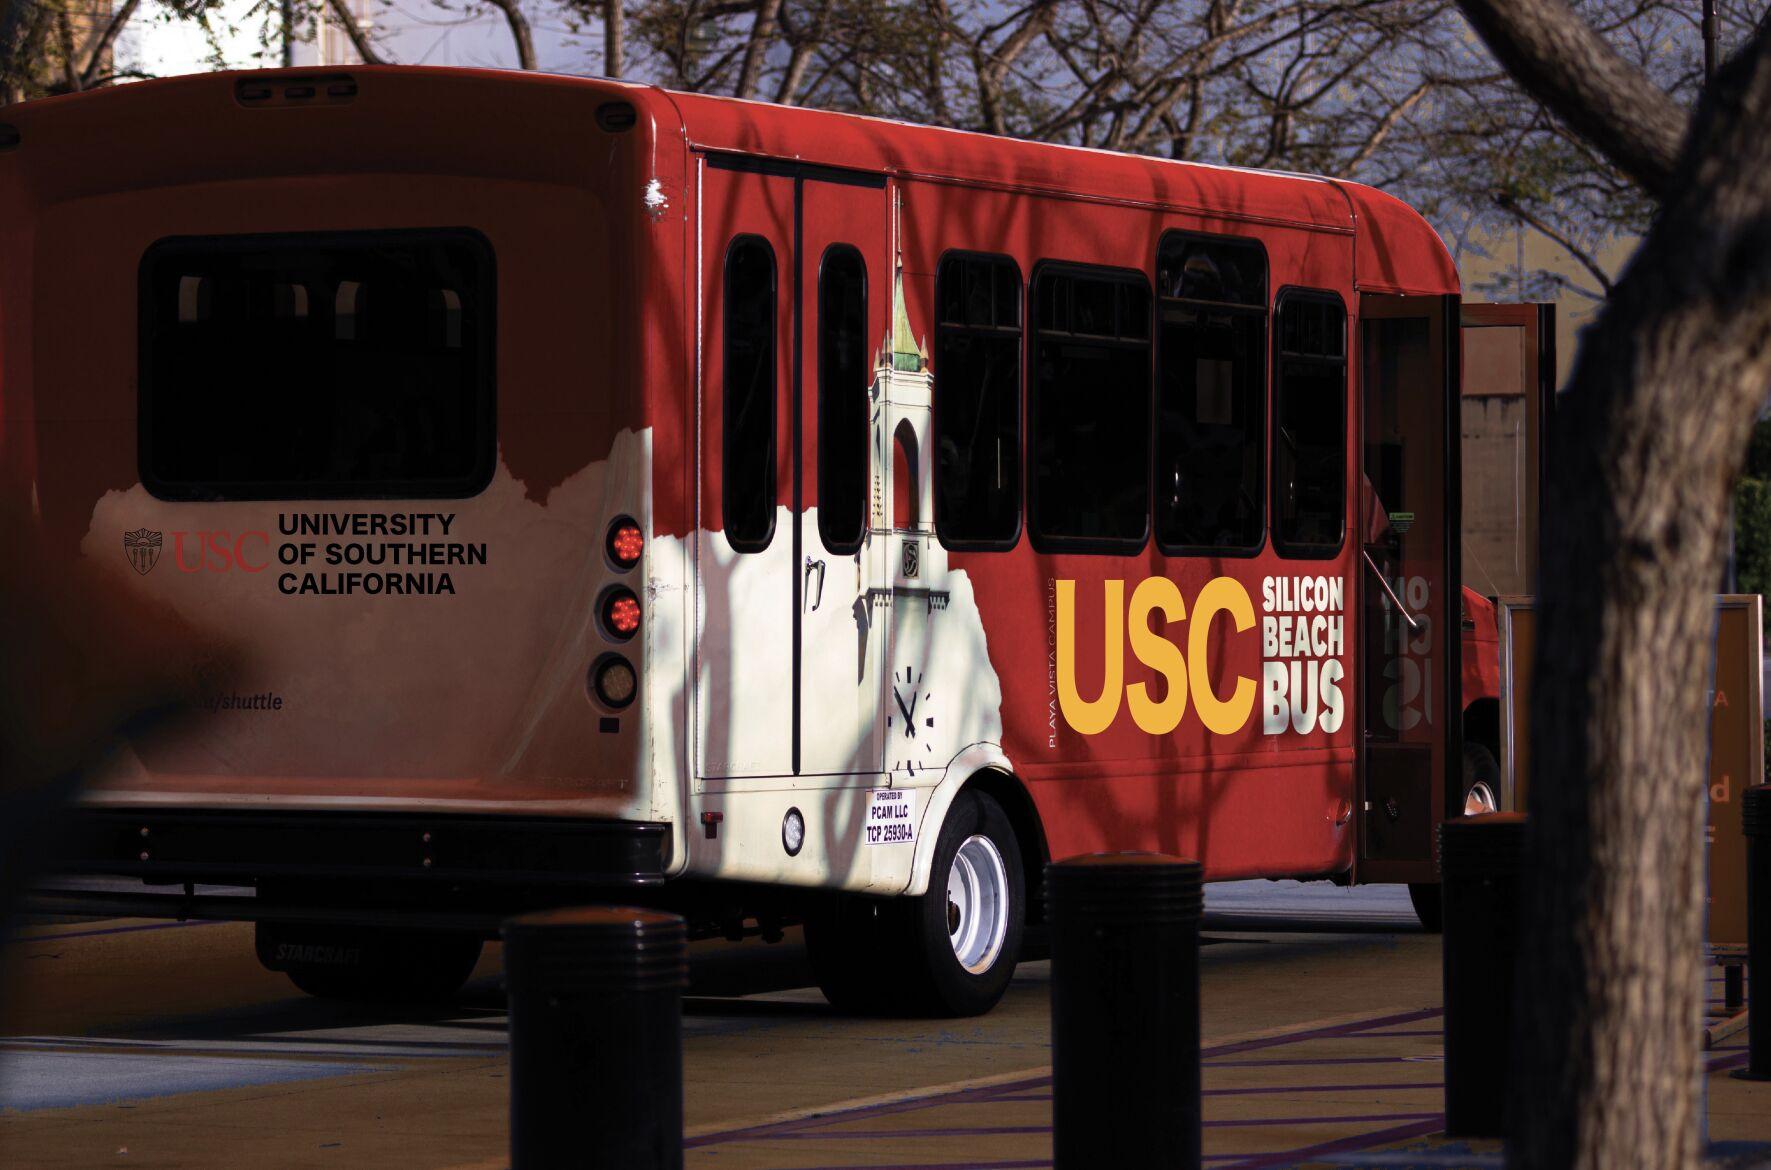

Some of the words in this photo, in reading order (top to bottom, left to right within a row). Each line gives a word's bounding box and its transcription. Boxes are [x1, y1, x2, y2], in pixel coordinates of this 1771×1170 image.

[278, 513, 456, 535] UNIVERSITY
[170, 530, 270, 573] USC
[278, 543, 315, 565] OF
[325, 543, 488, 565] SOUTHERN
[278, 573, 456, 595] CALIFORNIA
[1262, 575, 1344, 612] SILICON
[1263, 615, 1344, 657] BEACH
[1056, 576, 1257, 735] USC
[1048, 651, 1056, 695] VISTA
[1263, 659, 1344, 735] BUS
[877, 792, 896, 800] OPERATED
[872, 805, 893, 819] PCAM
[895, 804, 908, 818] LLC
[867, 825, 881, 842] TCP
[884, 824, 913, 841] 25930-A
